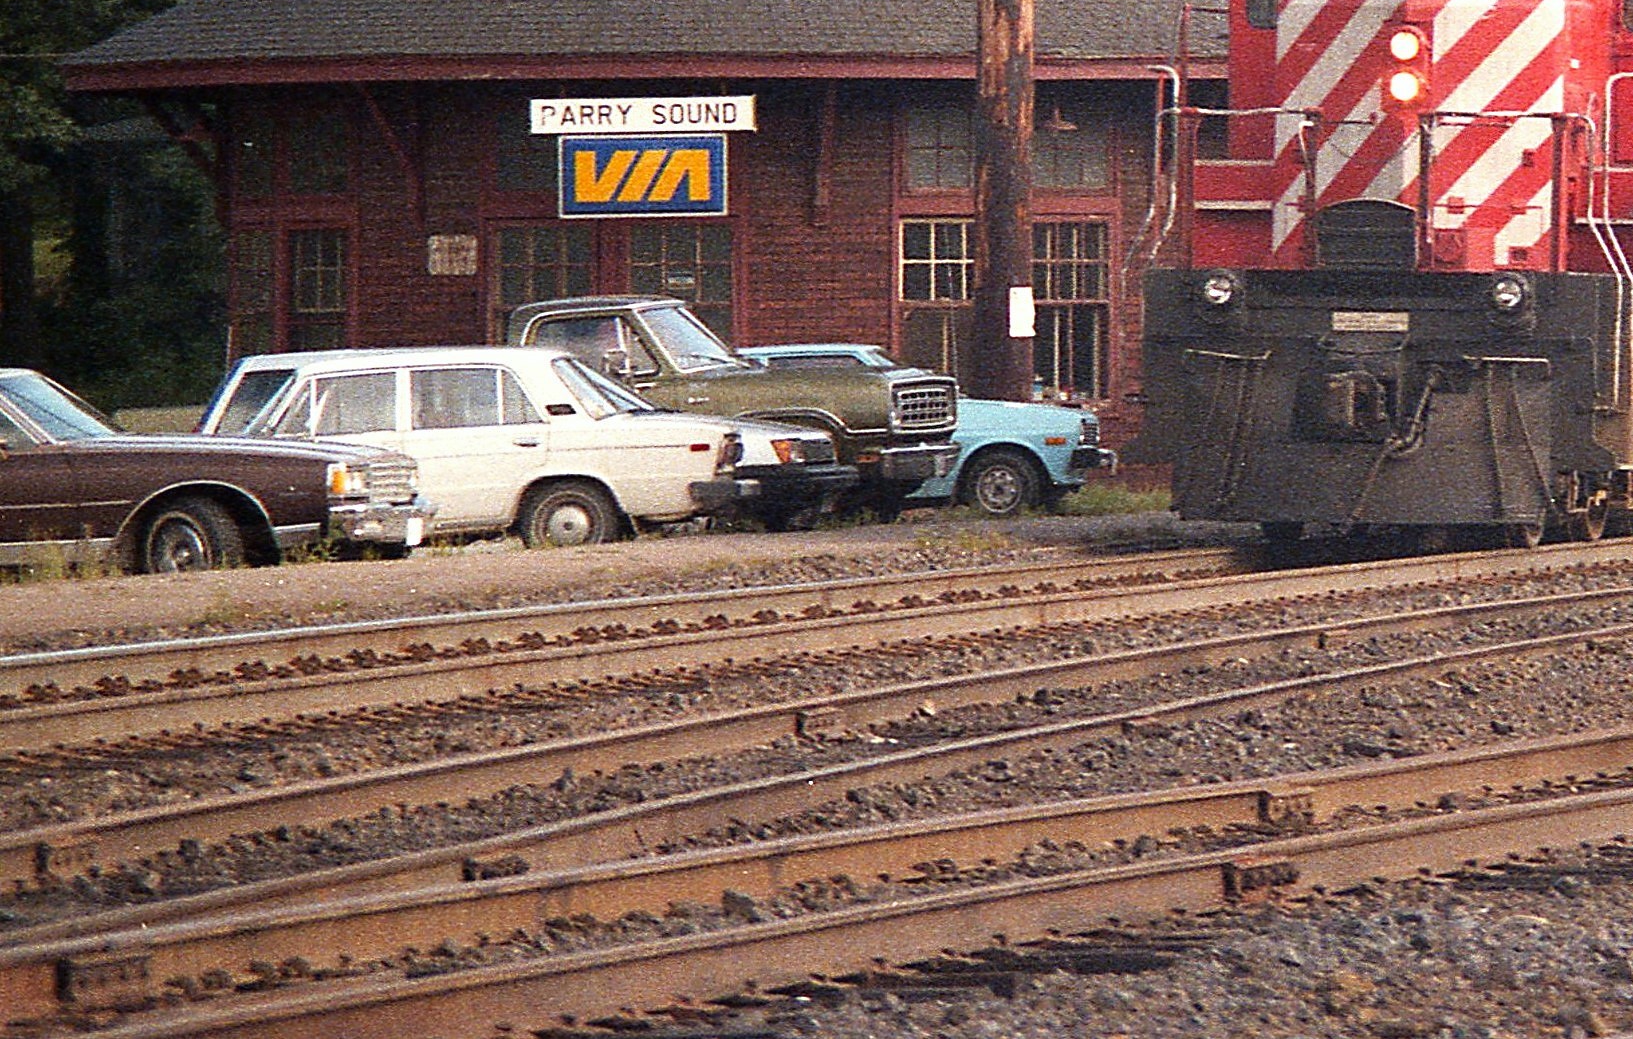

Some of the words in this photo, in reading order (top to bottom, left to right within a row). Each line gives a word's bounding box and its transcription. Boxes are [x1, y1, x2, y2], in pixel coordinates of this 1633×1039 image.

[540, 103, 633, 127] PARRY
[651, 102, 738, 125] SOUND
[573, 148, 711, 203] VIA
